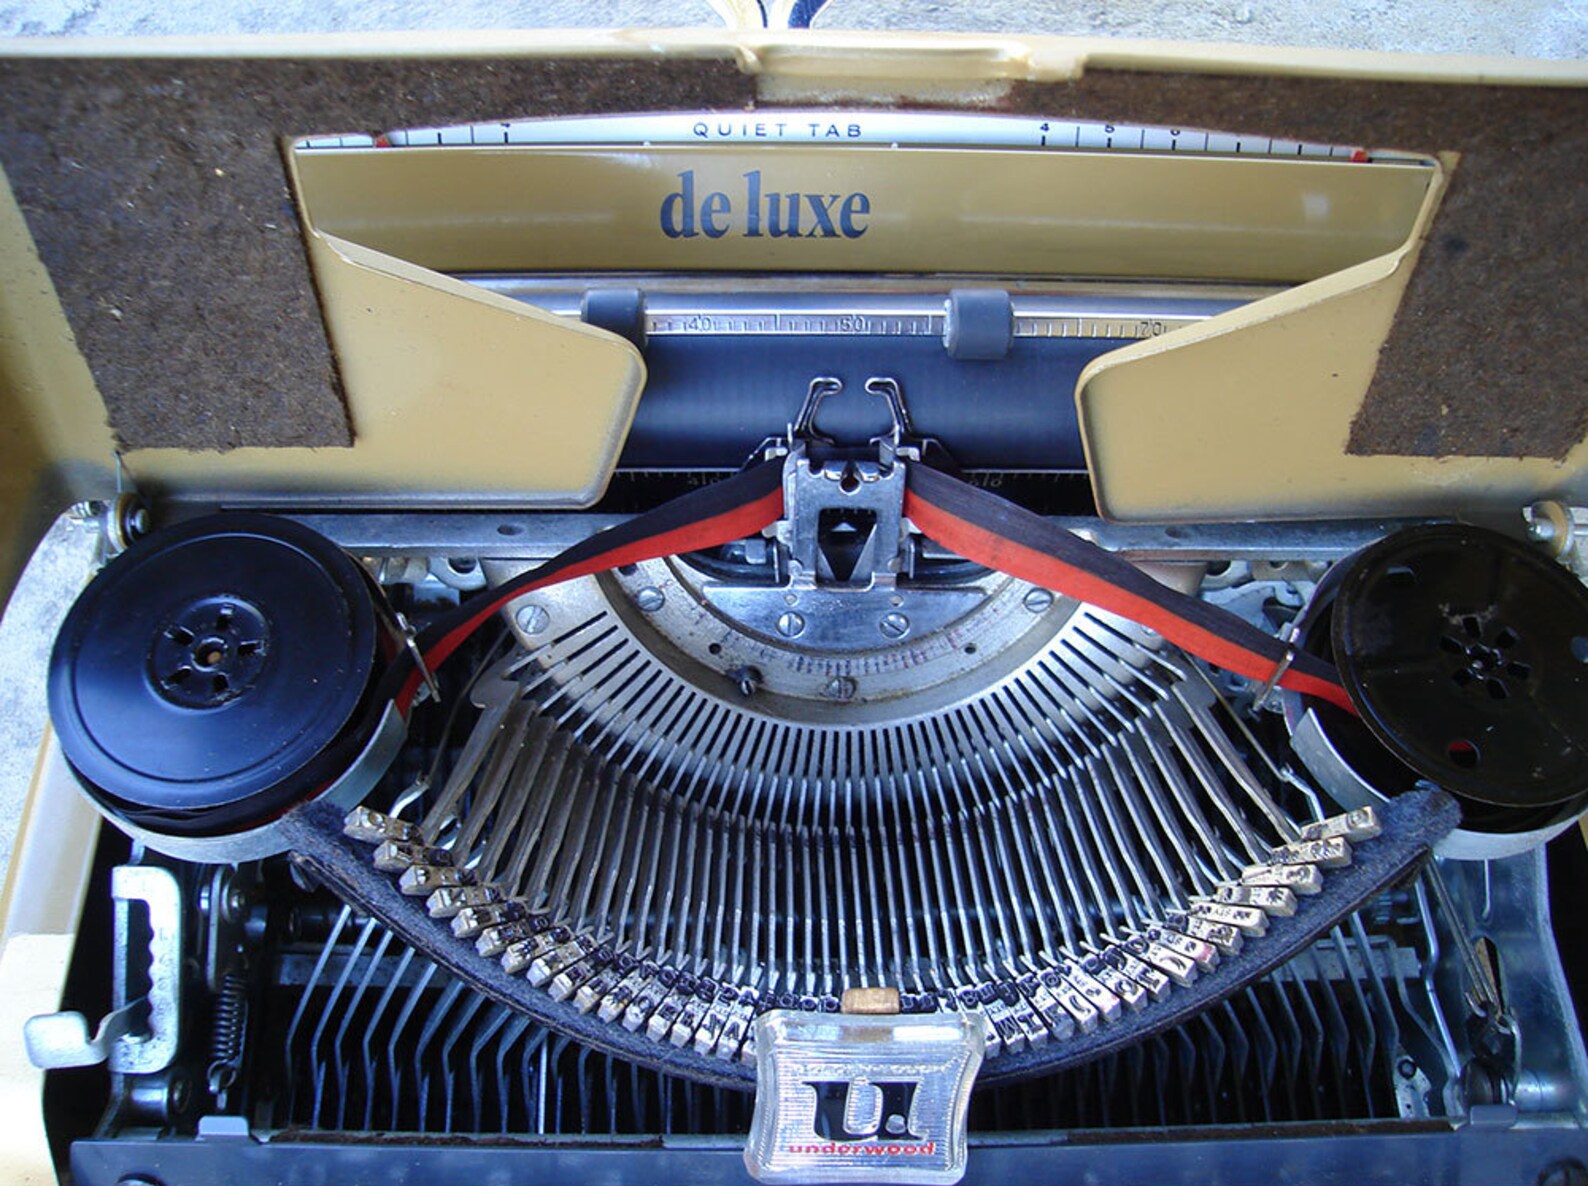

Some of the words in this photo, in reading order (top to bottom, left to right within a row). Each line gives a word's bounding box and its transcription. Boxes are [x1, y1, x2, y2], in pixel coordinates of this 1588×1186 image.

[693, 122, 787, 138] QUIET
[808, 123, 862, 138] TAB
[660, 169, 732, 239] de
[742, 169, 871, 239] luxe
[788, 1142, 936, 1155] underwood
